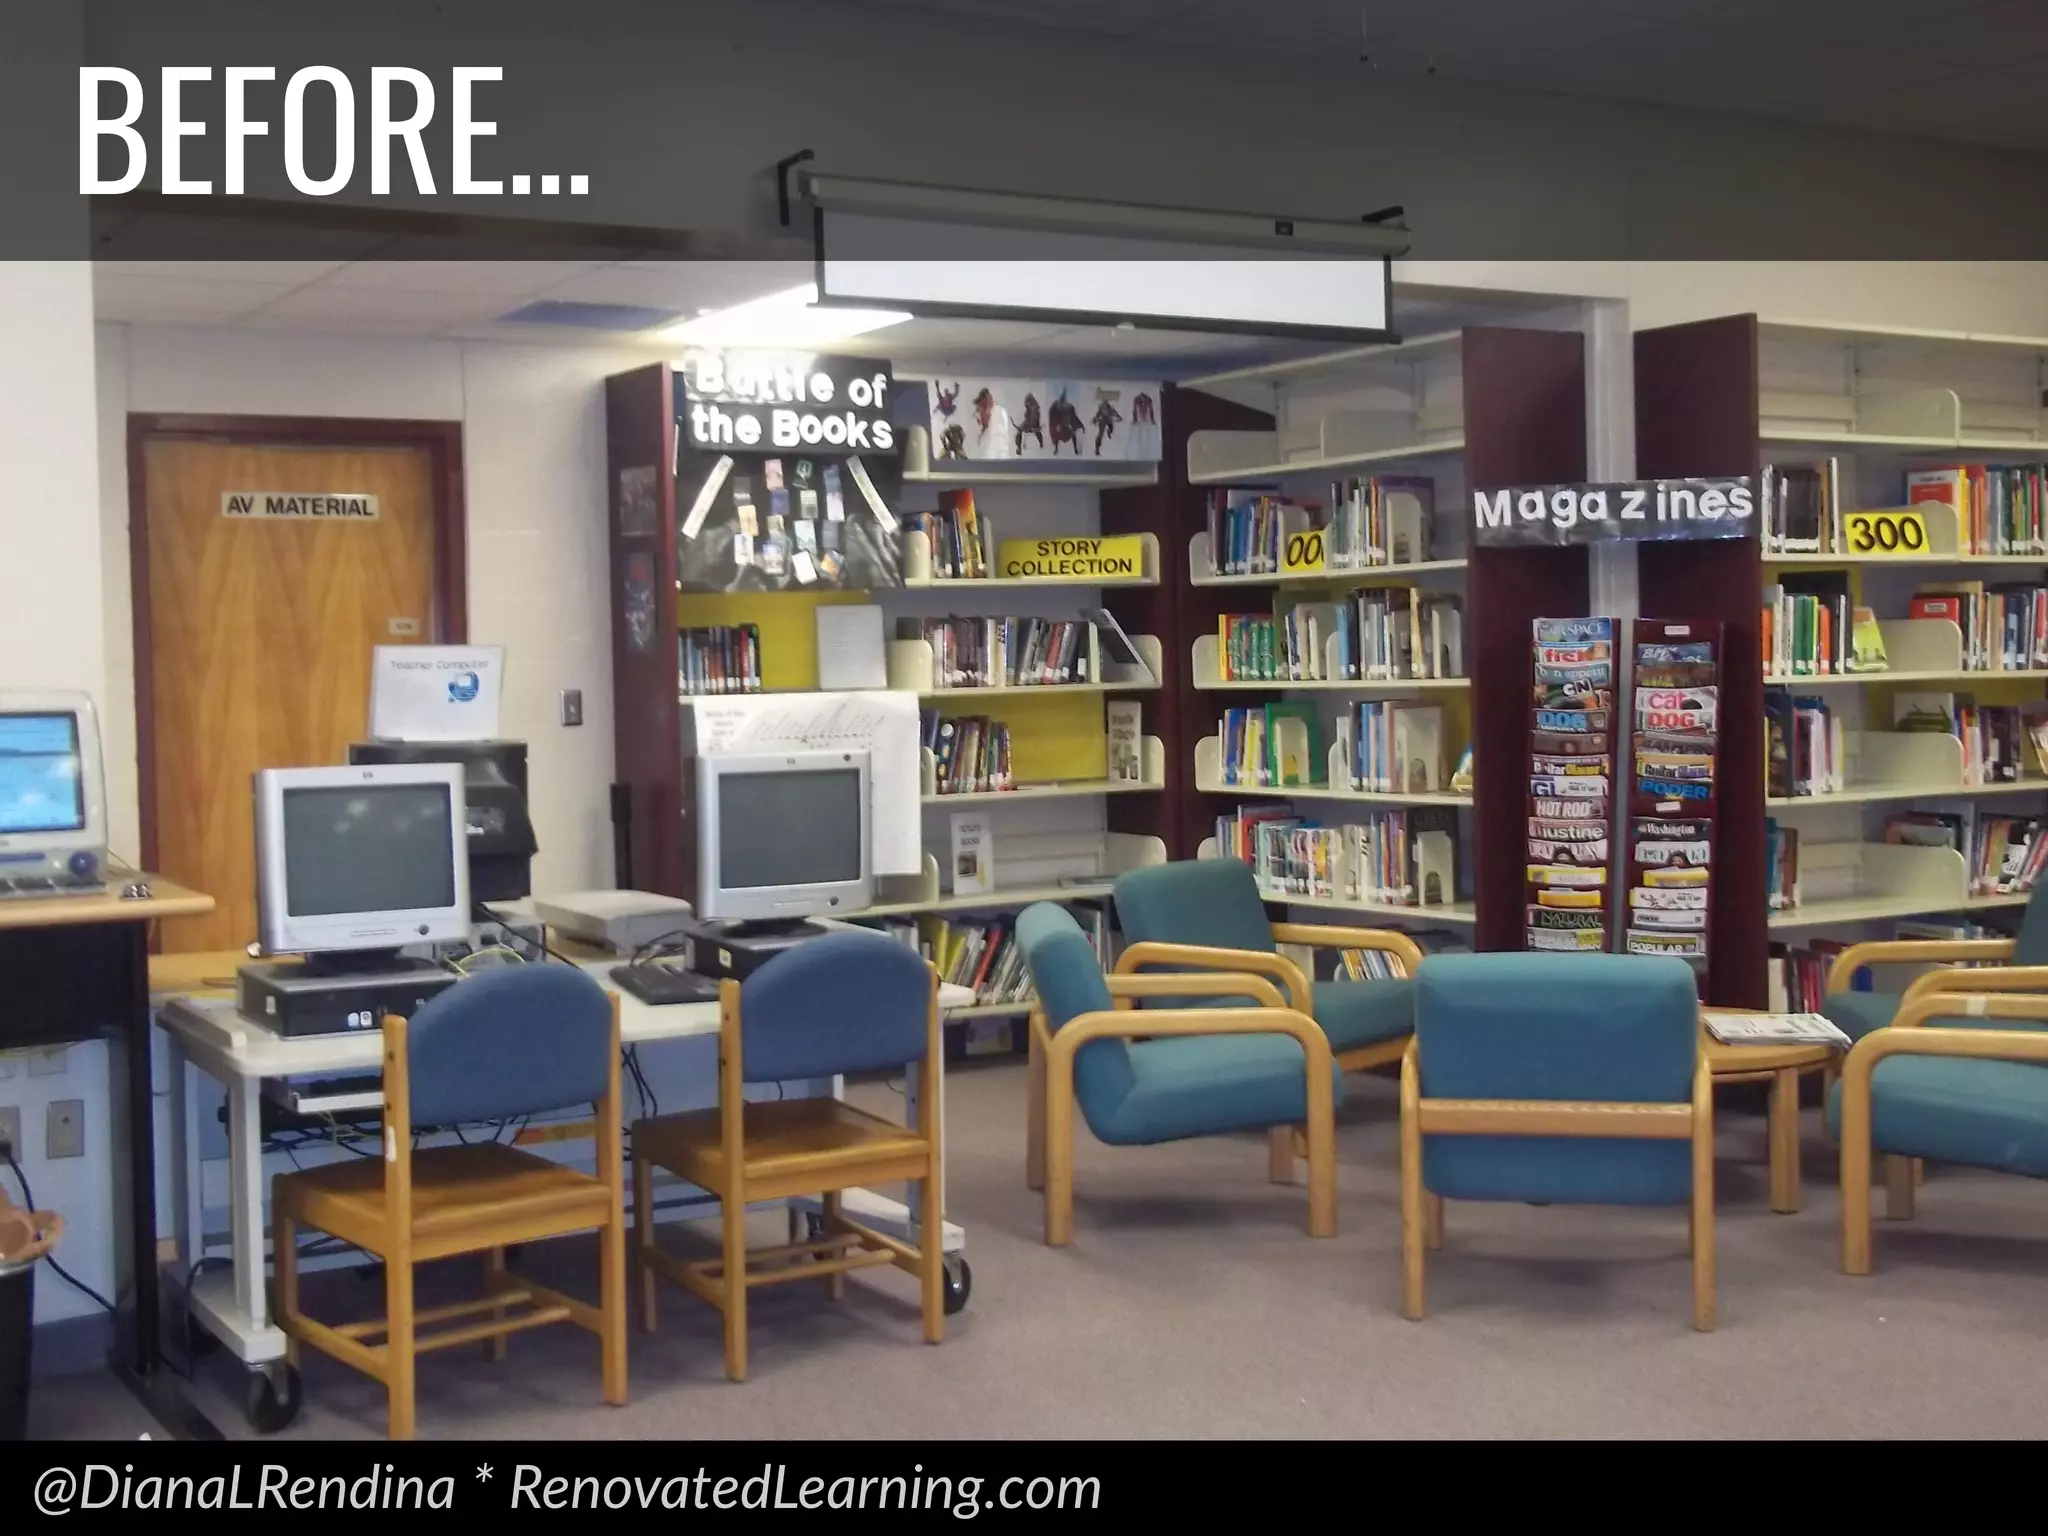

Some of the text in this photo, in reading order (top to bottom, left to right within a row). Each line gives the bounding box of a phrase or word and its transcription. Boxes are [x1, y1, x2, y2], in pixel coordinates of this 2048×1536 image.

[694, 354, 888, 408] Battle of
[691, 403, 894, 450] the Books
[227, 496, 375, 517] AV MATERIAL
[1851, 516, 1923, 551] 300
[1037, 540, 1102, 557] STORY
[1007, 558, 1133, 577] COLLECTION
[436, 659, 489, 671] Computer
[1539, 712, 1587, 728] DOG
[1648, 713, 1695, 727] DOG
[1639, 780, 1708, 799] PODER
[1536, 801, 1590, 817] HOT ROD
[1646, 823, 1696, 838] Washington
[1541, 911, 1603, 926] NATURAL
[1630, 942, 1683, 954] POPULAR
